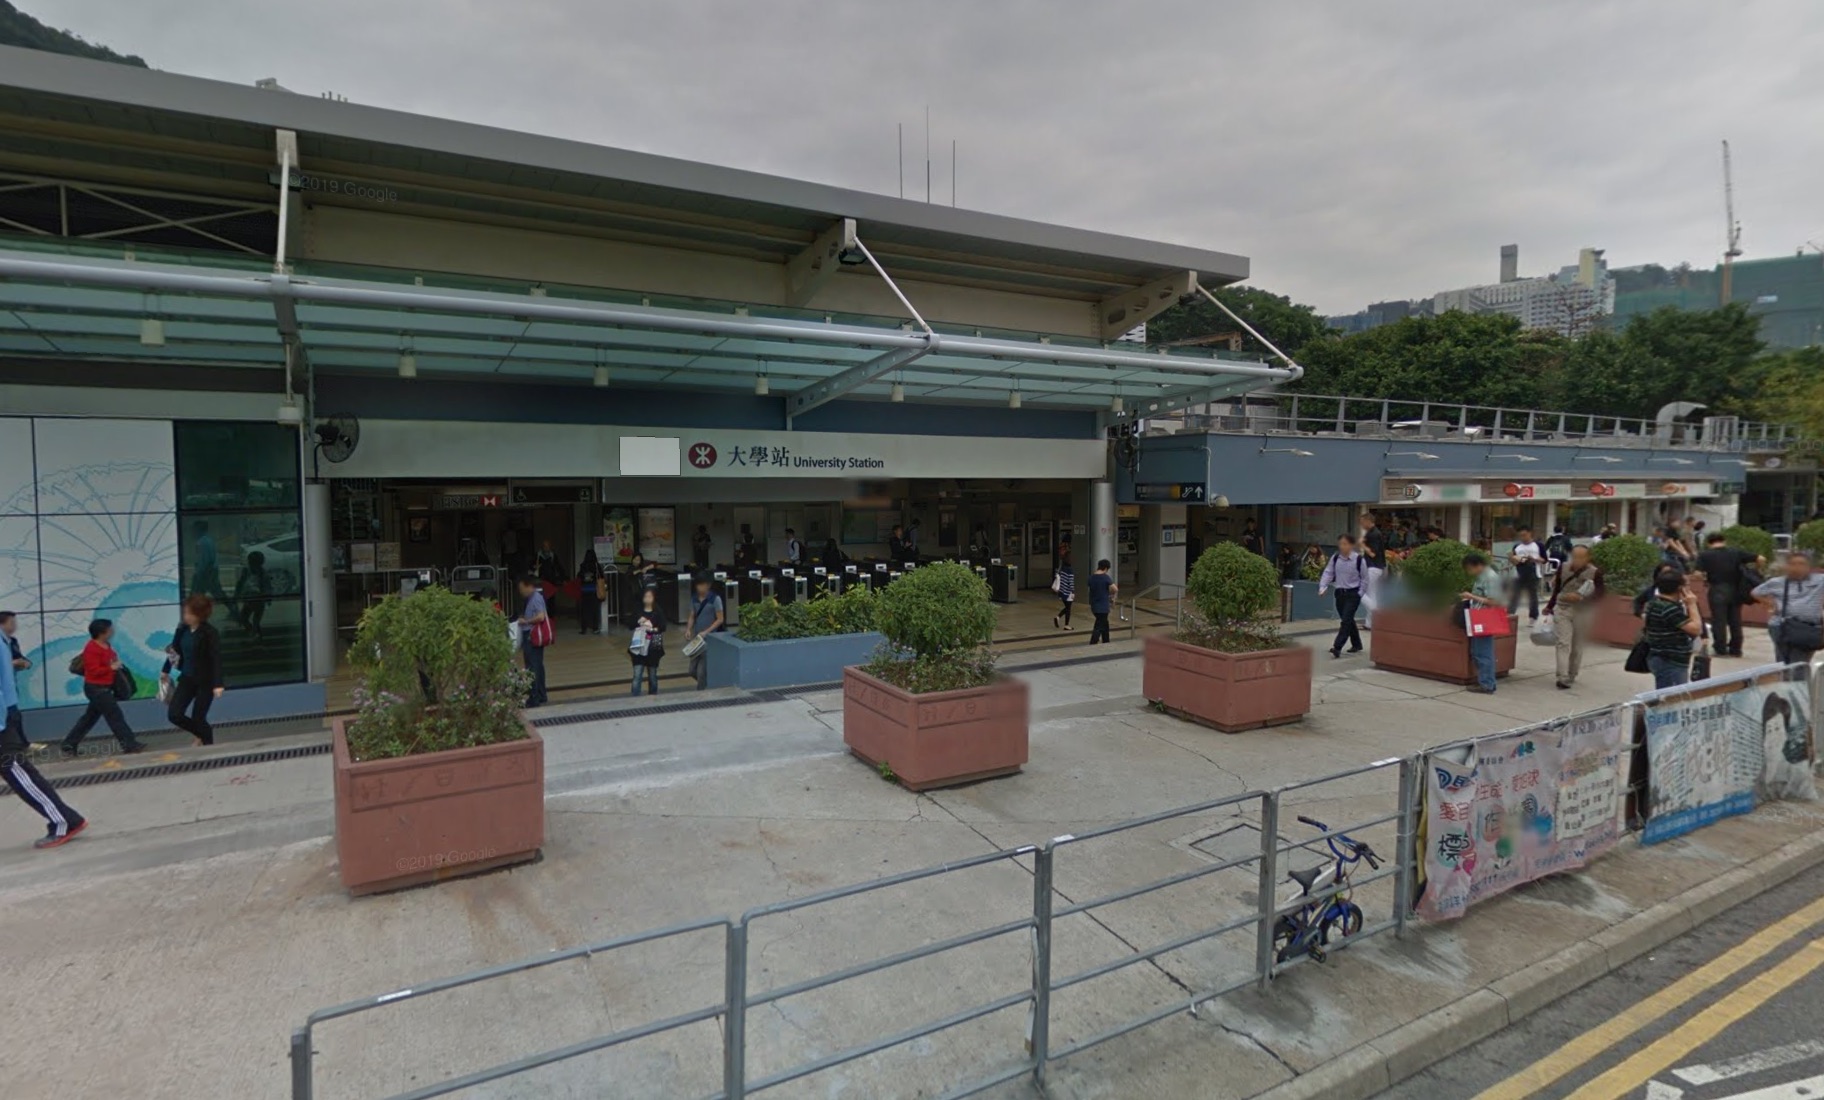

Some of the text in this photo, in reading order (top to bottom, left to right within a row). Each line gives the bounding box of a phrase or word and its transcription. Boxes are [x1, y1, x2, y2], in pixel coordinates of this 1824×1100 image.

[727, 446, 790, 468] 大學站
[793, 456, 884, 470] University Station
